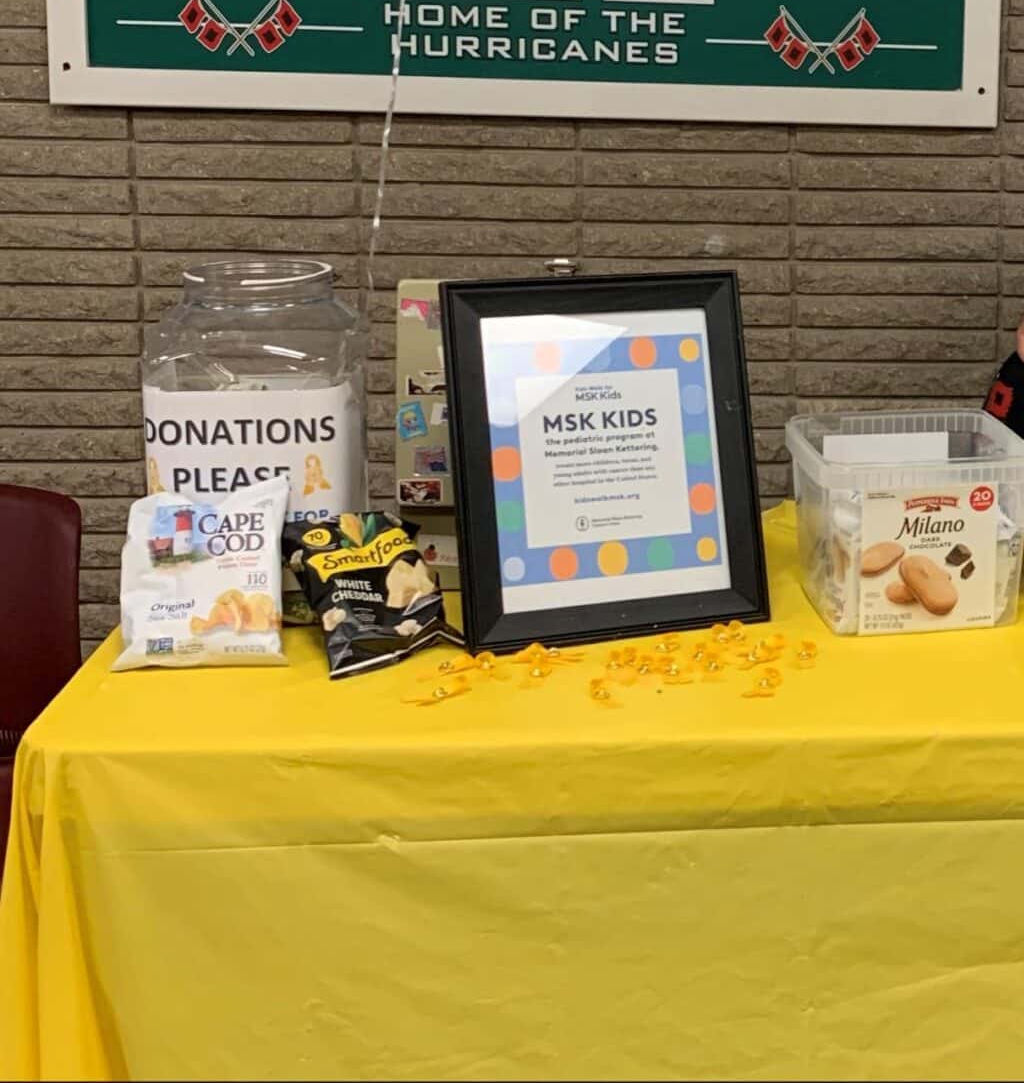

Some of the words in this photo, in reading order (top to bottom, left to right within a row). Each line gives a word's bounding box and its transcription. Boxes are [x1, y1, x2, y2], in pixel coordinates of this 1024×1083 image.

[384, 3, 509, 28] HOME
[530, 8, 586, 31] OF
[602, 11, 686, 35] THE
[391, 34, 679, 64] HURRICANES
[145, 416, 335, 446] DONATIONS
[543, 412, 596, 433] MSK
[602, 408, 657, 429] KIDS
[974, 490, 990, 501] 20
[198, 512, 264, 535] CAPE
[895, 516, 965, 540] Milano
[207, 533, 264, 557] COD
[331, 590, 384, 603] CHEDDAR
[334, 578, 373, 591] WHITE
[151, 599, 195, 612] Original
